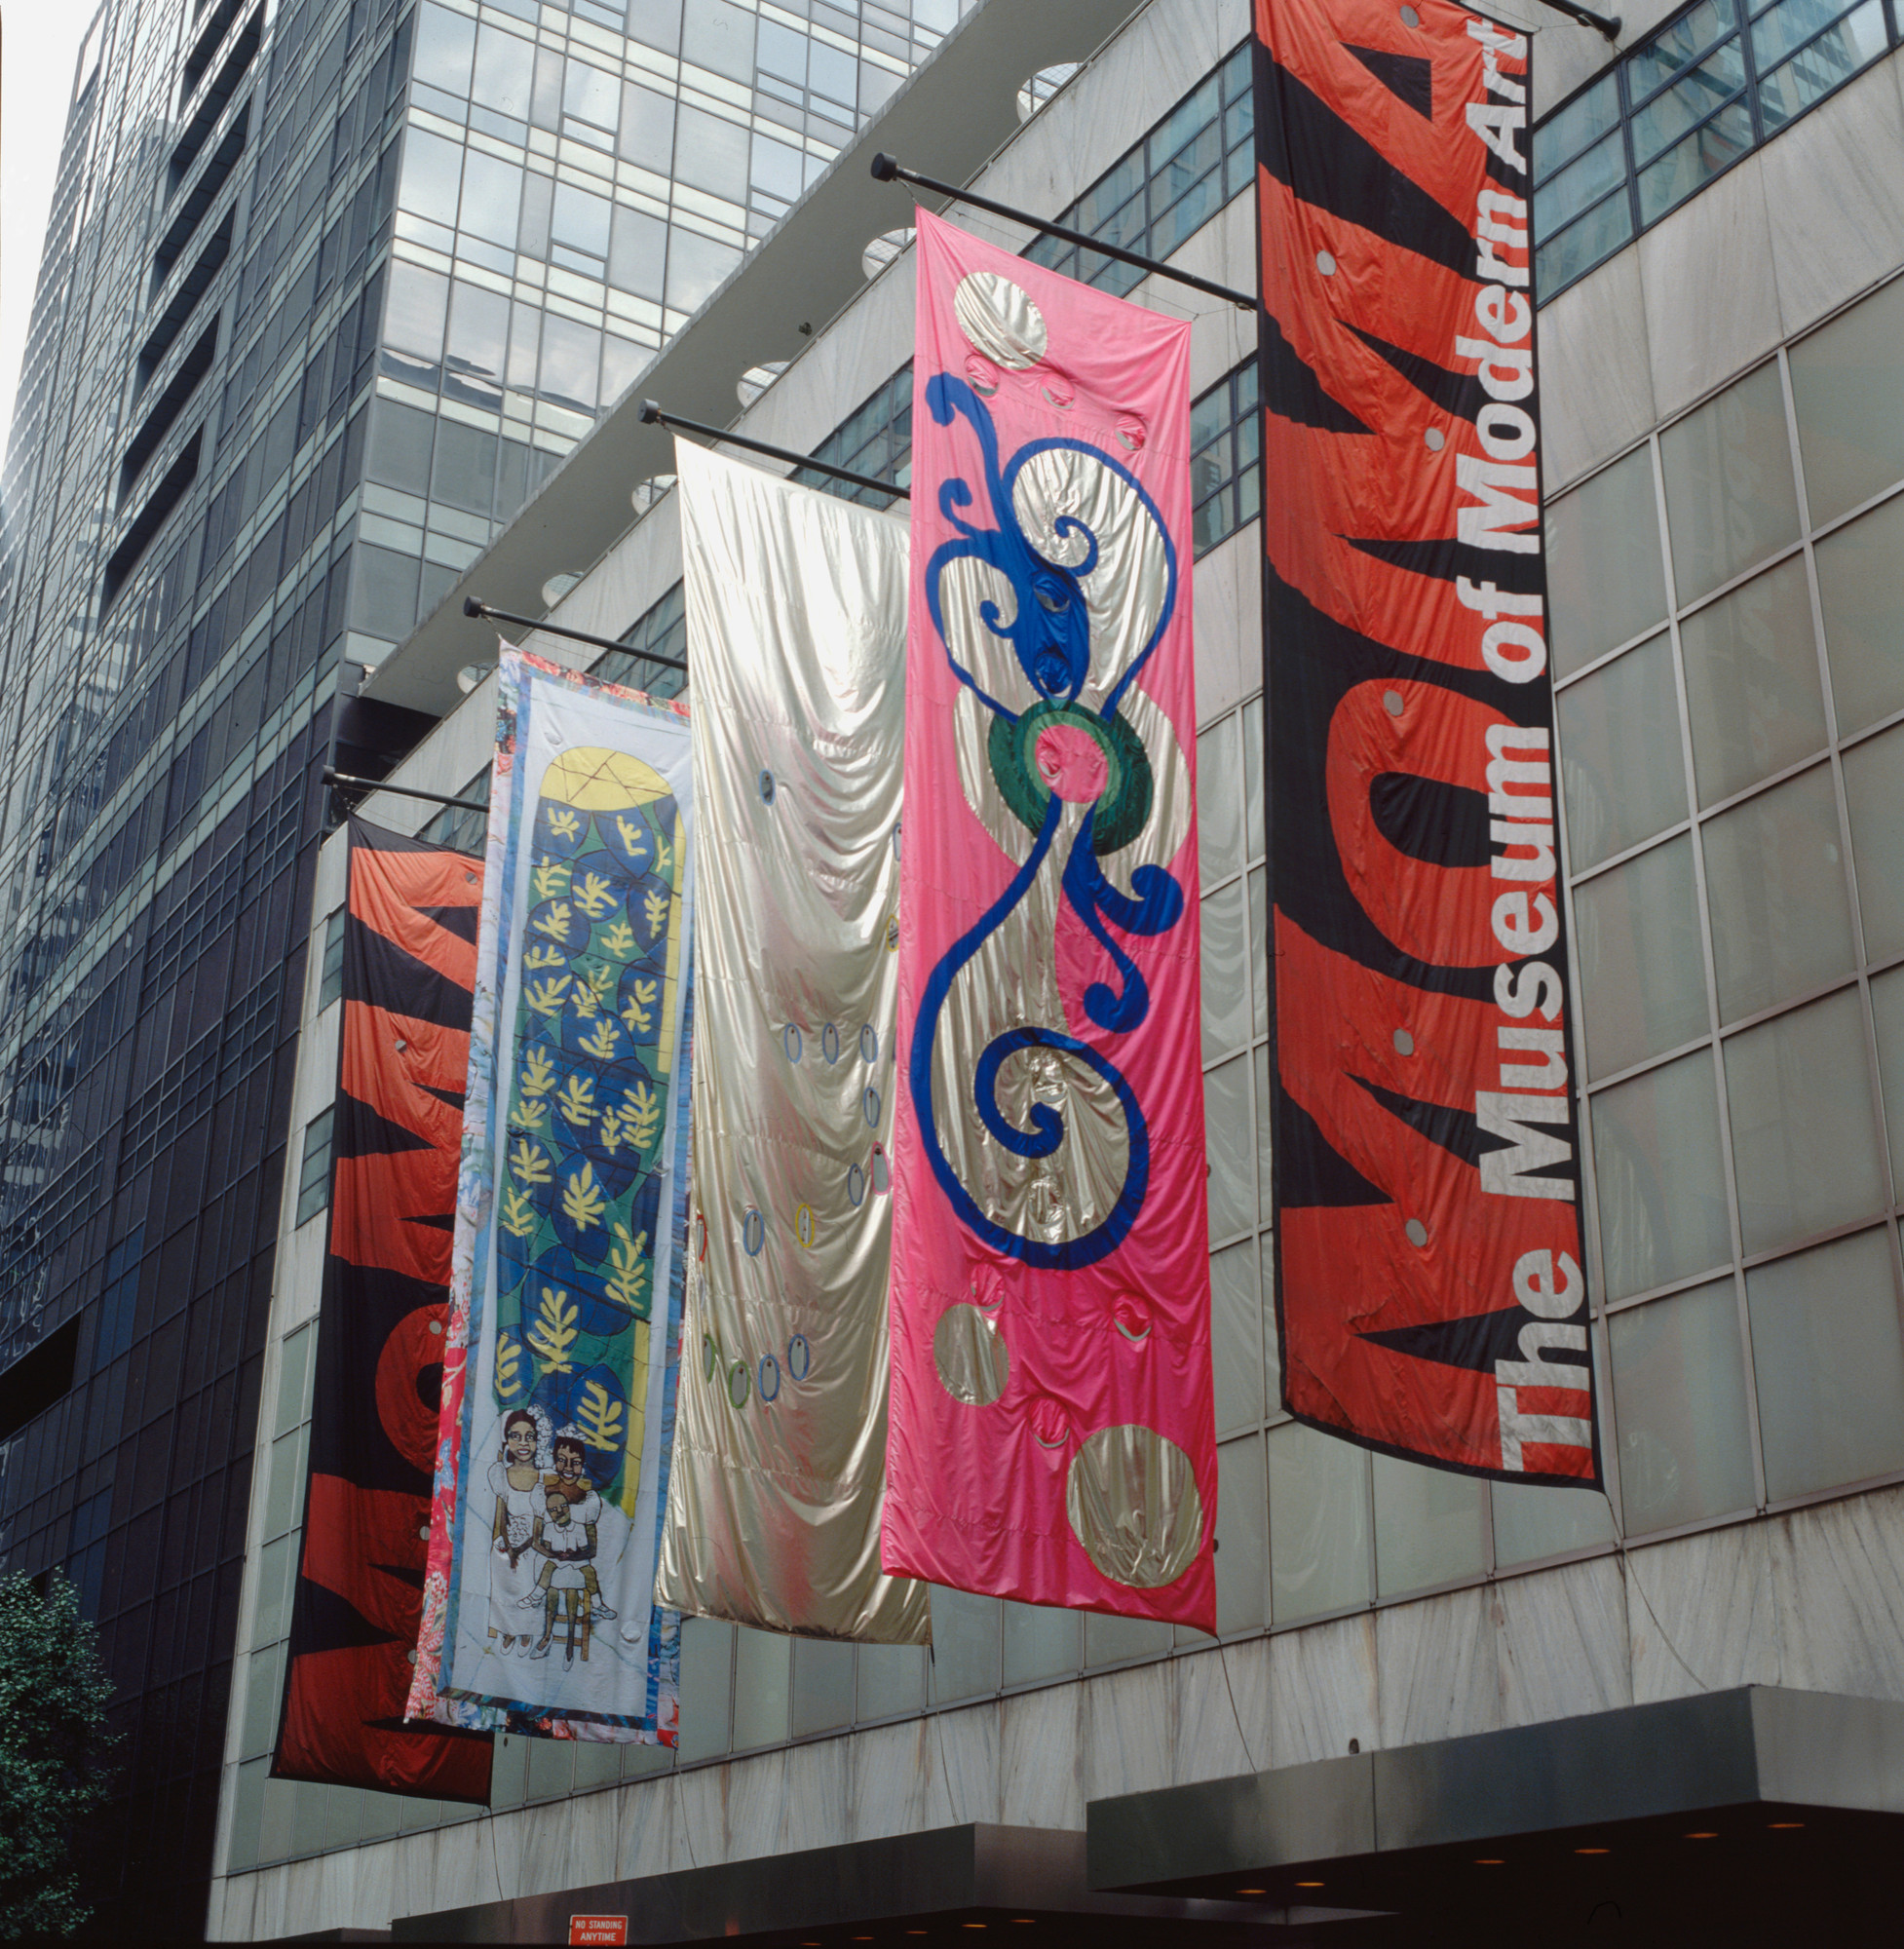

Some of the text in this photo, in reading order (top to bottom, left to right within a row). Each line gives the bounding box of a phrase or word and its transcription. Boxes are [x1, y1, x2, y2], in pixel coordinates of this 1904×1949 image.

[1456, 19, 1593, 1472] The Museum of Modern Art
[575, 1920, 623, 1930] NO STANDING
[580, 1931, 617, 1941] ANYTIME
